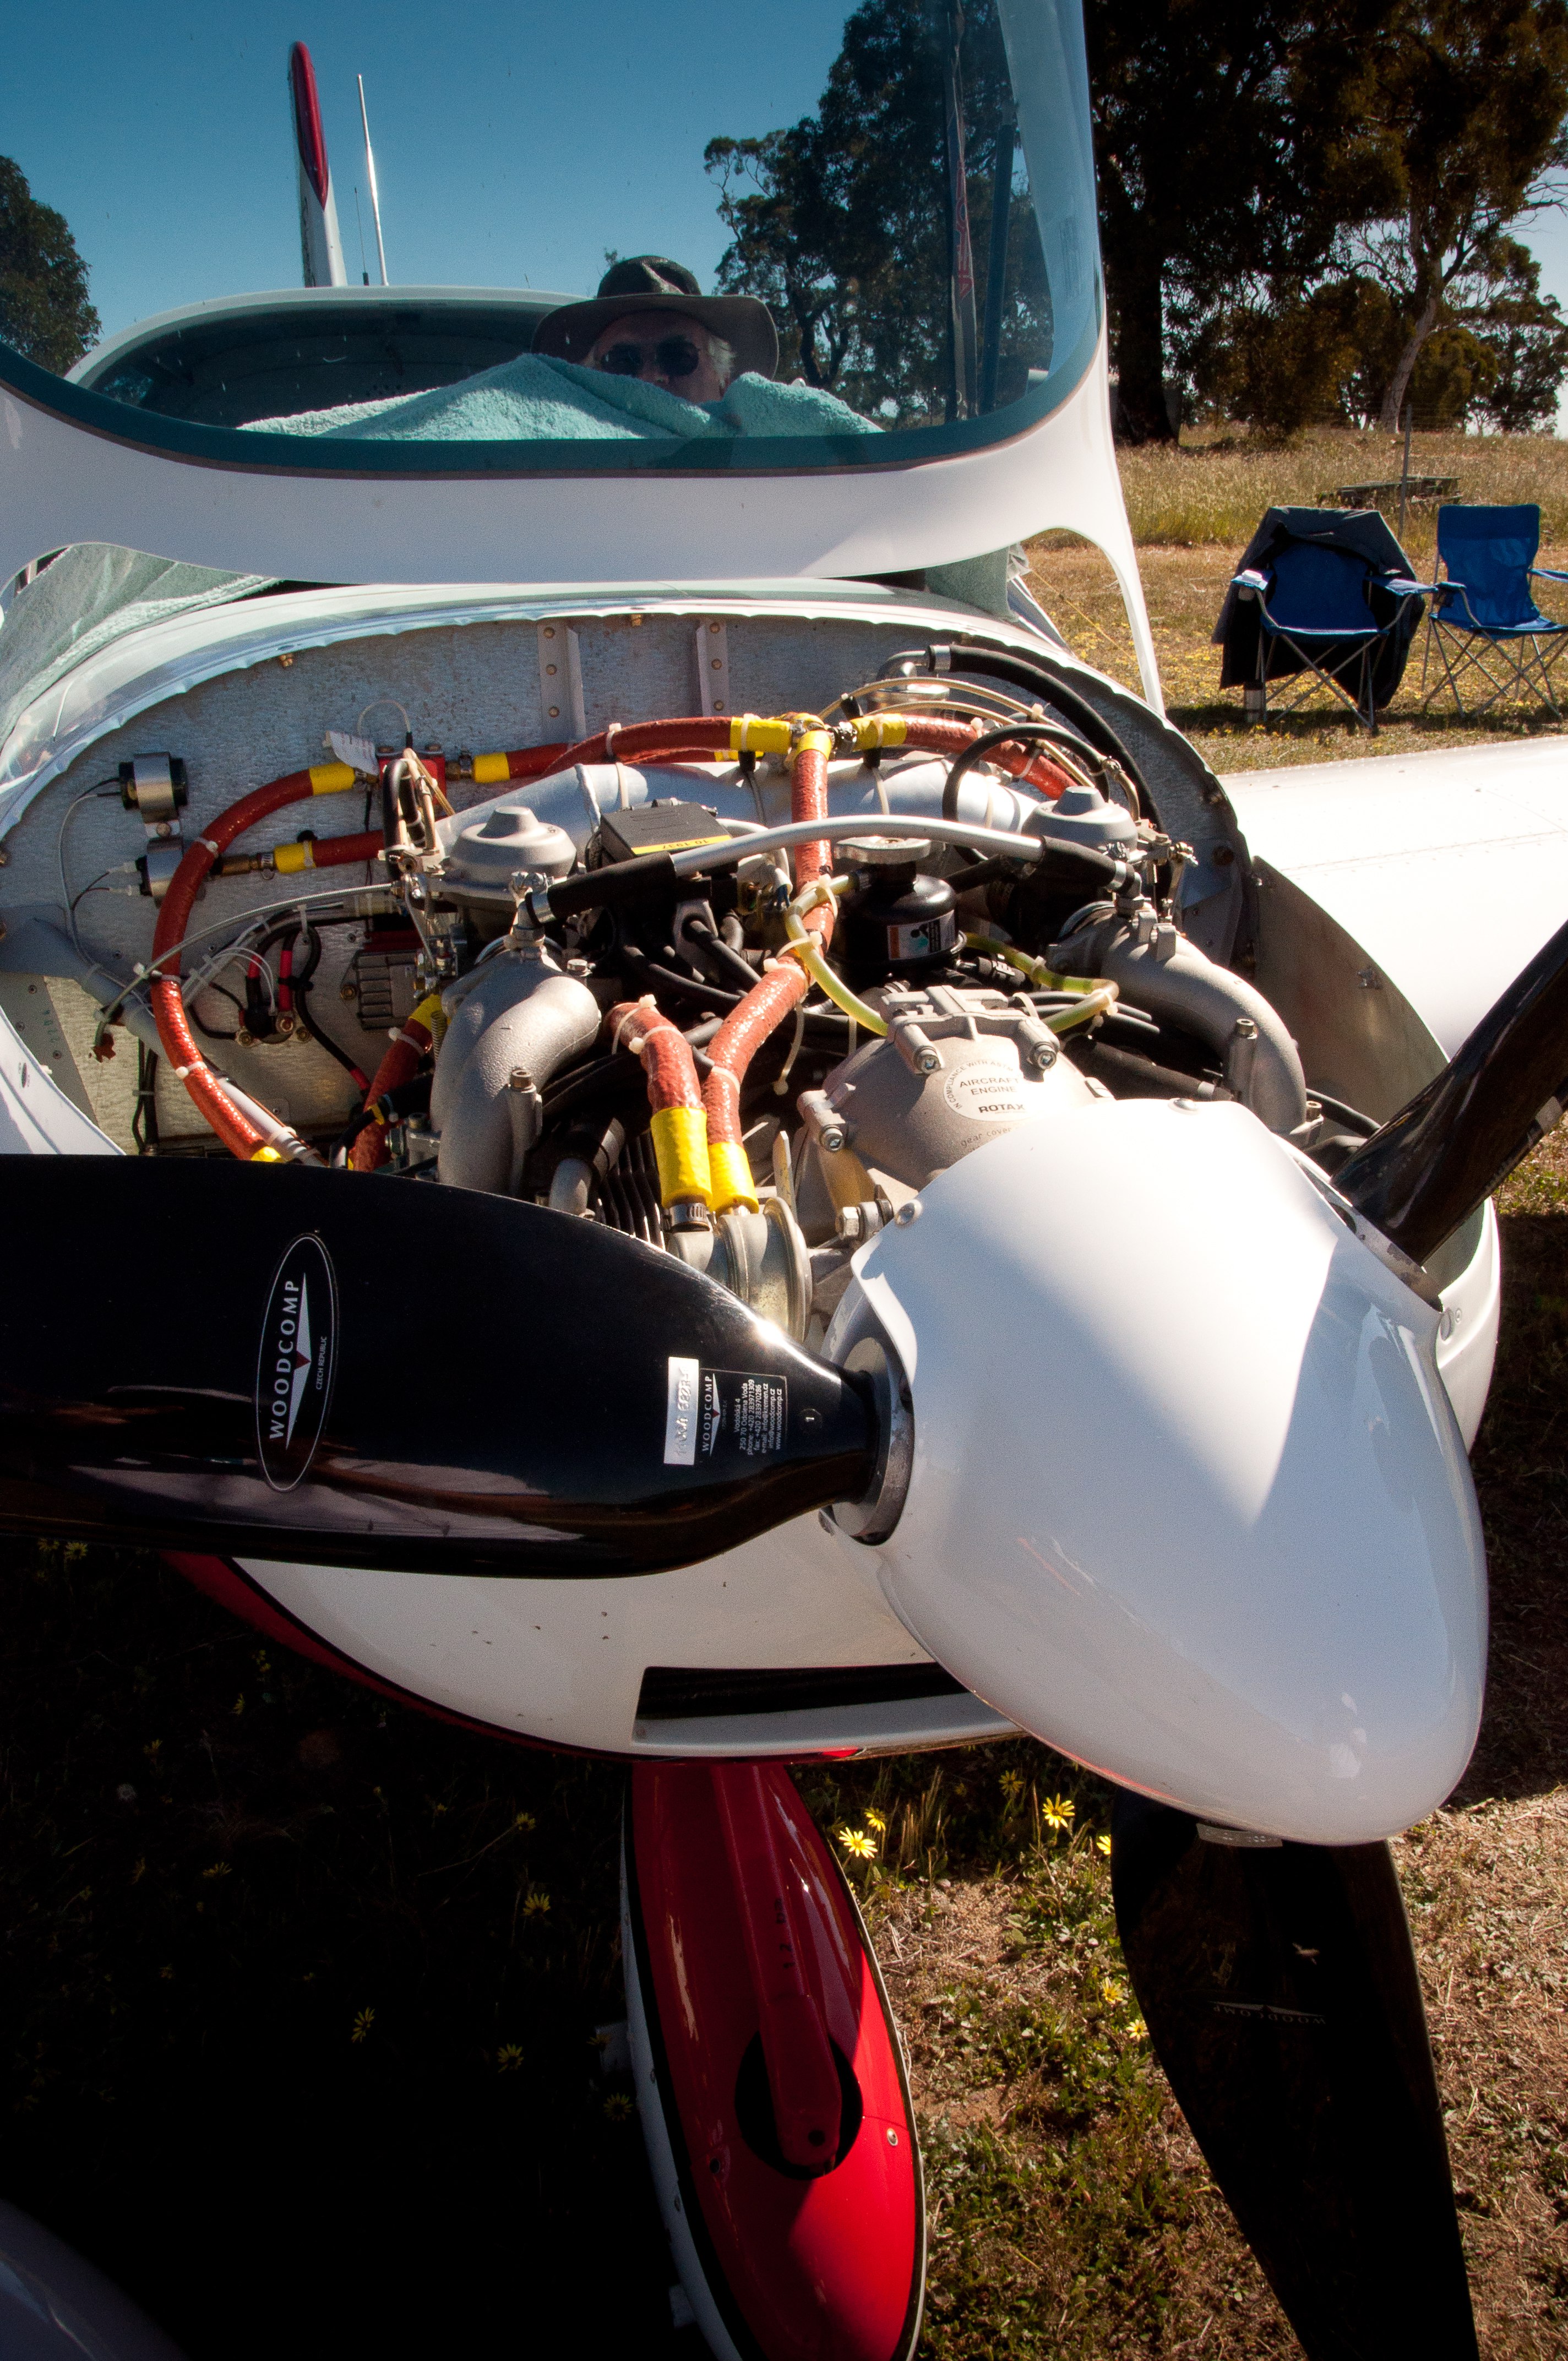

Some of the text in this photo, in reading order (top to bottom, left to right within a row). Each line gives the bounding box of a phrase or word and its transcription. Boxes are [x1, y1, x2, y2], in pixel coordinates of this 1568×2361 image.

[946, 1065, 966, 1102] COMPLIANCE
[990, 1060, 1014, 1071] ASTM
[960, 1078, 1019, 1087] AIRCRAFT
[971, 1086, 1017, 1095] ENGINE
[978, 1104, 1025, 1113] ROTAX
[961, 1127, 1011, 1149] gear cover
[269, 1280, 300, 1440] WOODCOMP
[315, 1336, 327, 1390] CZECH REPUBLIC
[702, 1375, 712, 1451] WOODCOMP
[1213, 2004, 1326, 2025] WOODCOMP
